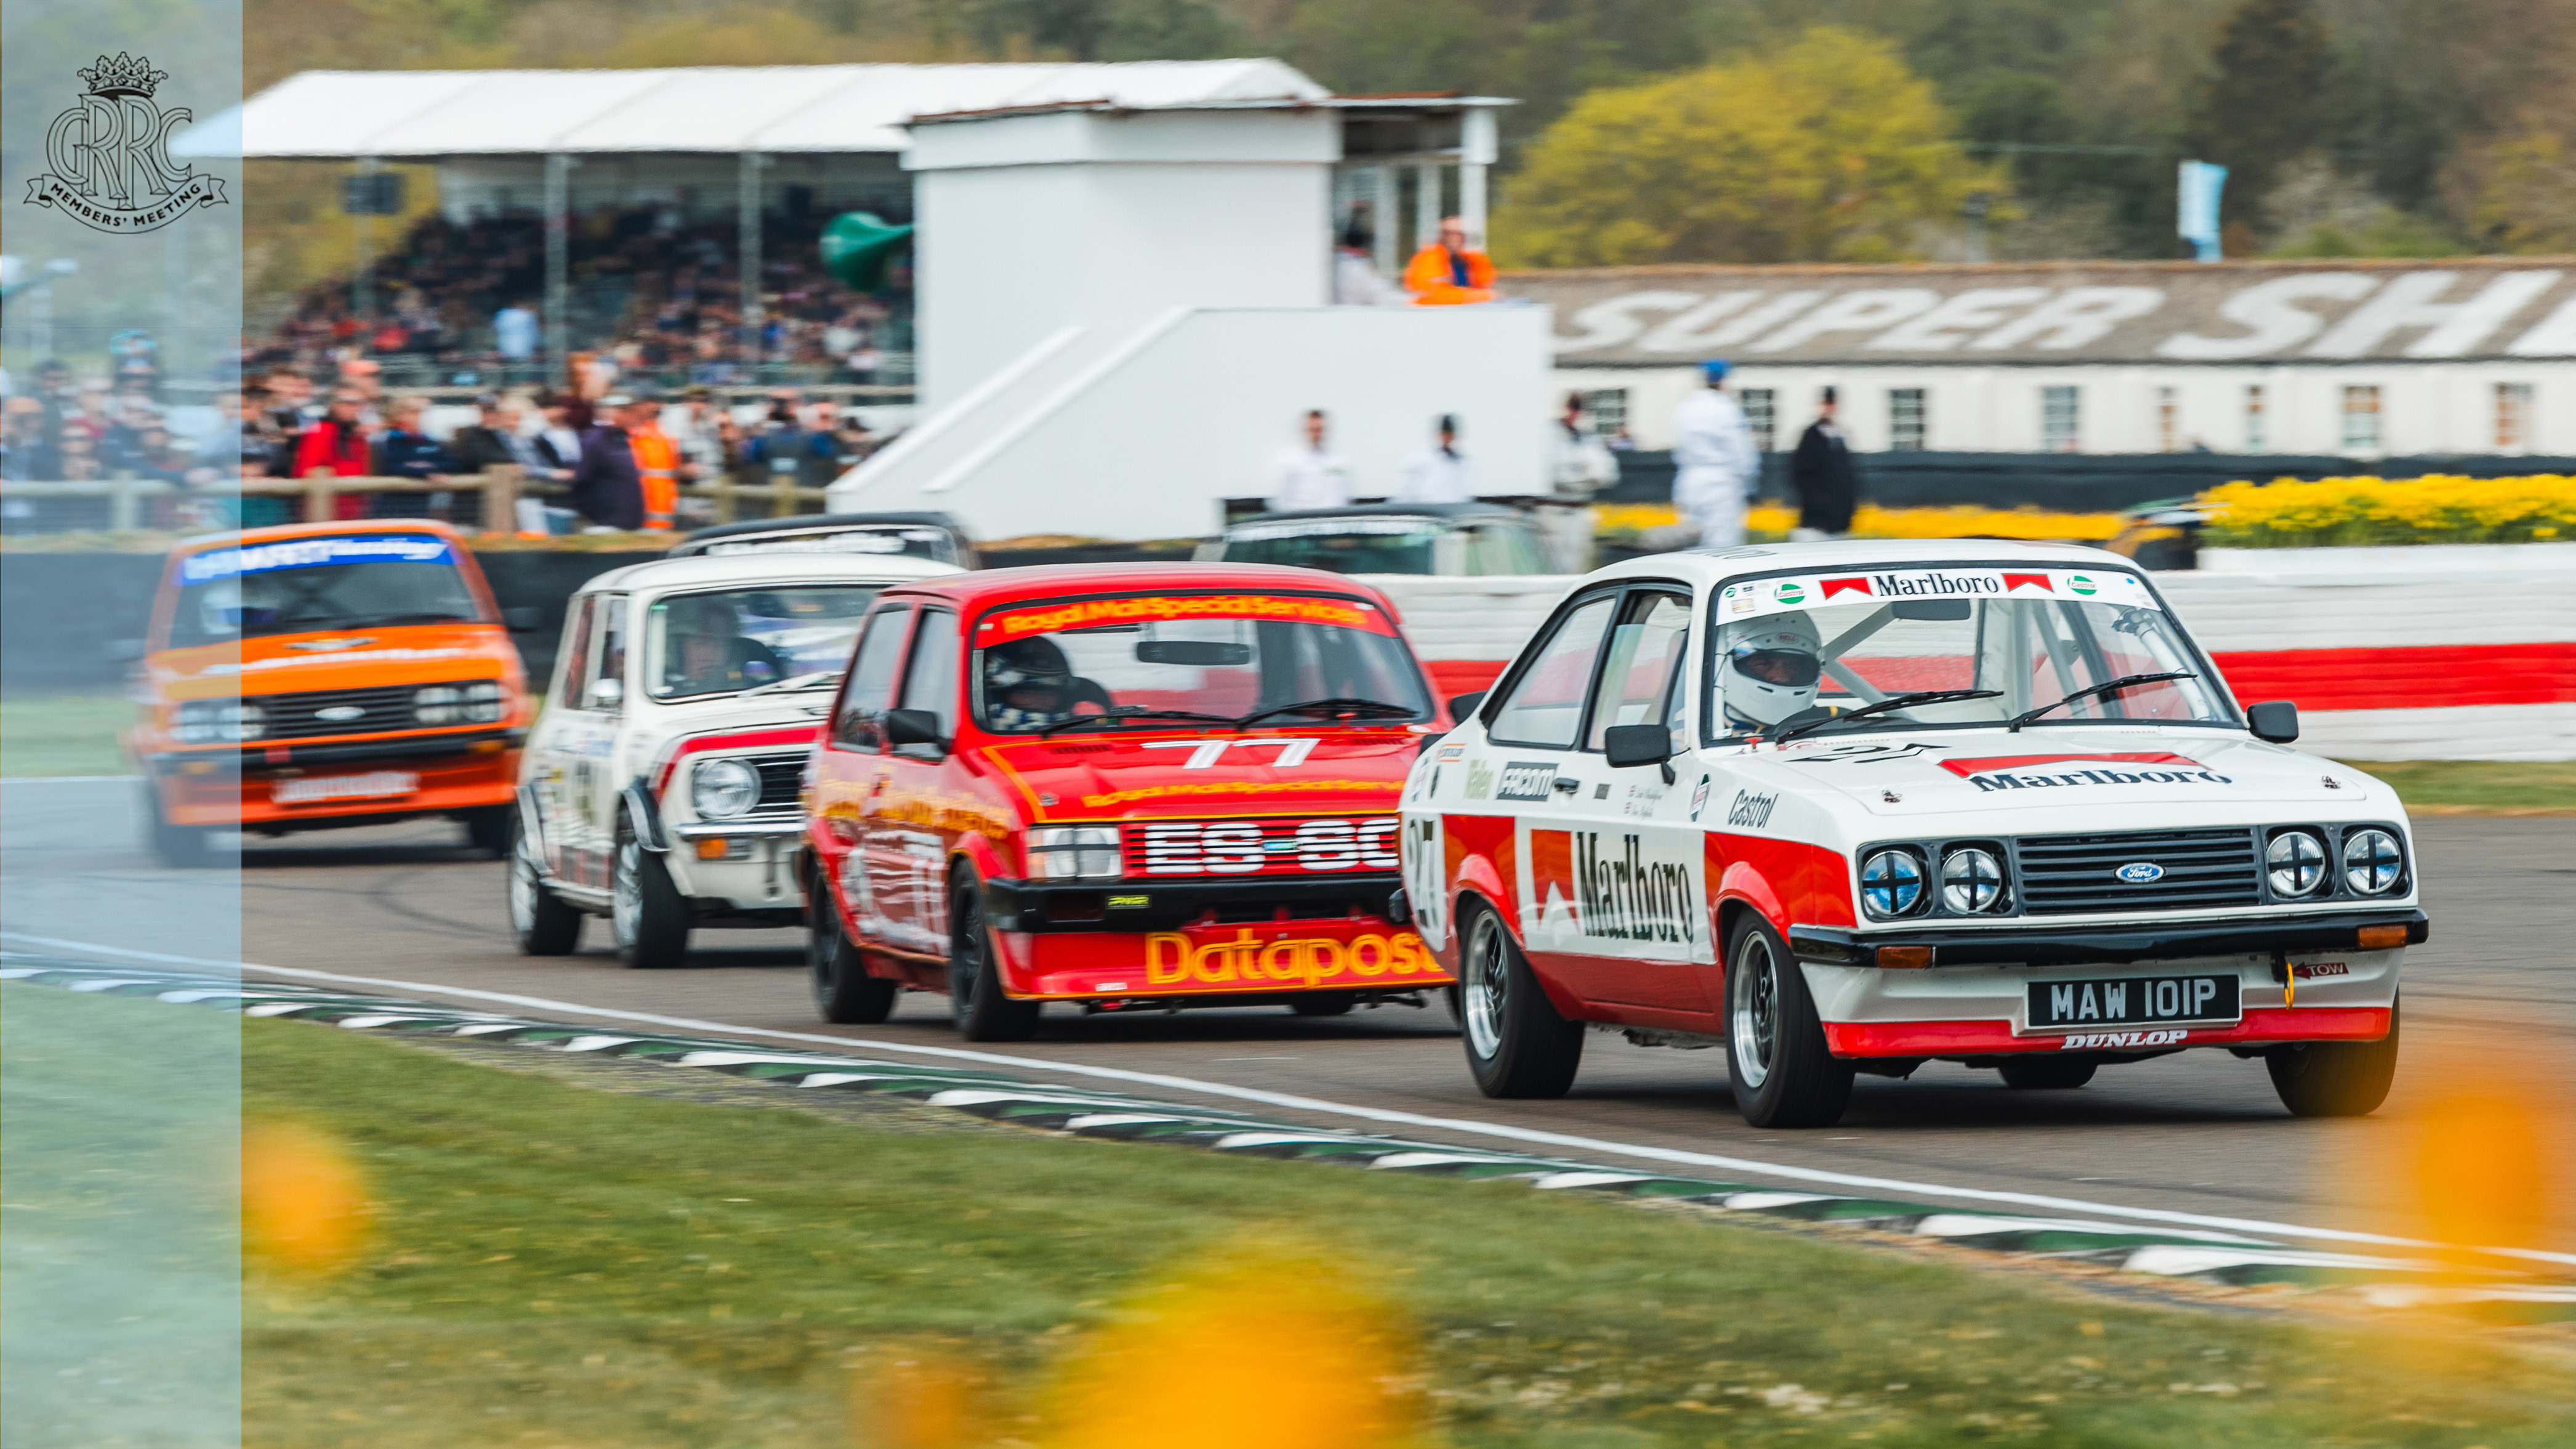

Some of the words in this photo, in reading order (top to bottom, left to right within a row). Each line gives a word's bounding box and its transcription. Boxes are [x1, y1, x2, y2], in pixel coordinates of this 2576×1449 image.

[1553, 288, 2165, 353] SUPER
[1874, 573, 1998, 596] Marlboro
[1145, 596, 1249, 619] Special
[1139, 738, 1321, 770] 77
[1966, 769, 2232, 792] Marlboro
[1728, 788, 1780, 828] Castrol
[2127, 866, 2152, 878] Ford
[1576, 831, 1693, 944] Marlboro
[2306, 964, 2345, 976] TOW
[2051, 982, 2127, 1020] MAW
[2145, 979, 2216, 1017] 101P
[2061, 1030, 2188, 1049] DUNLOP
